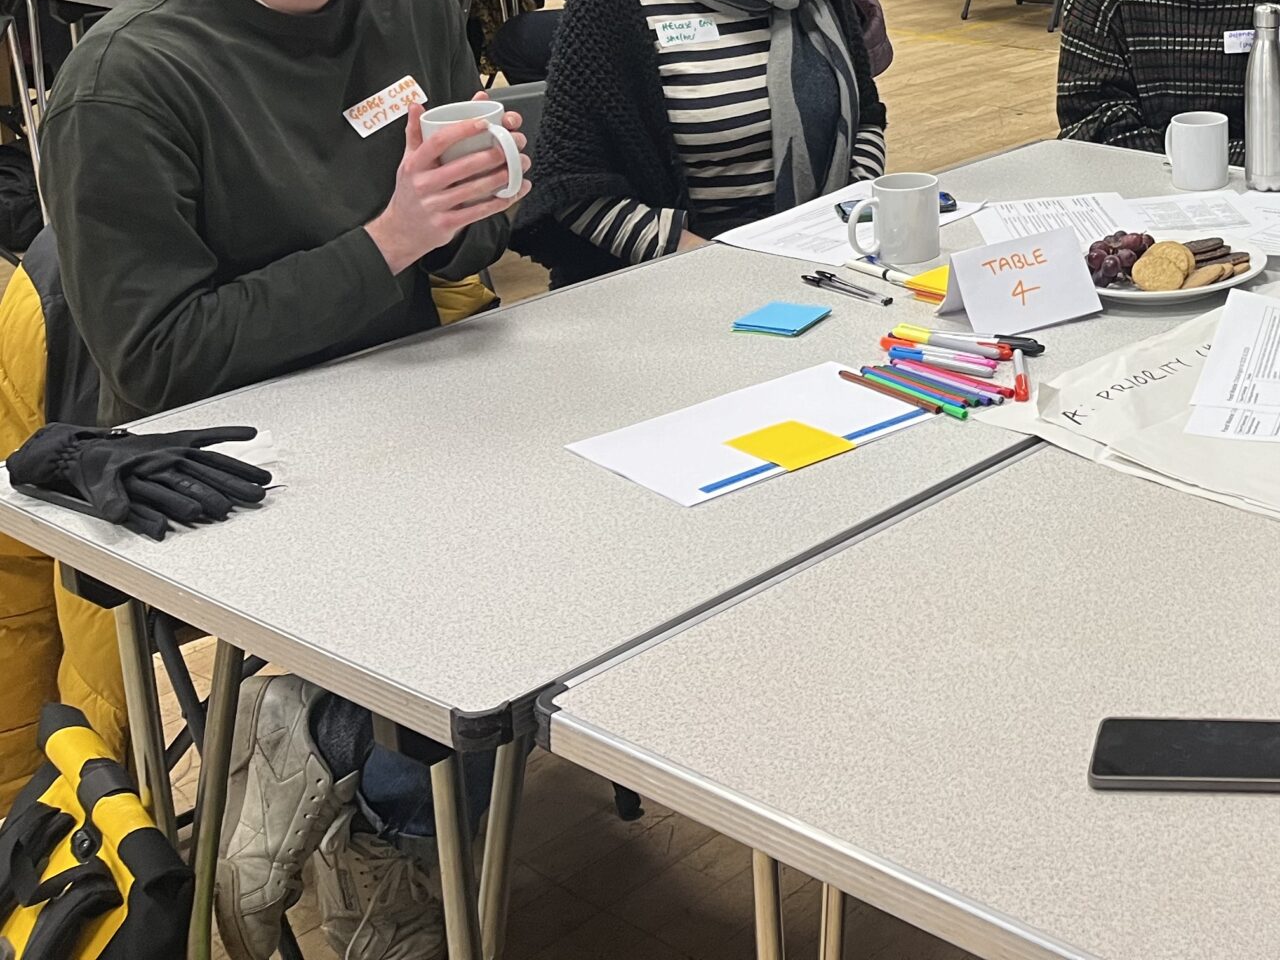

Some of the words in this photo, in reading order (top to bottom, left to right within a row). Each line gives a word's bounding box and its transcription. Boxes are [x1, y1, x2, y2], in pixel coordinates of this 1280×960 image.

[348, 95, 385, 120] GEORGE
[363, 109, 388, 130] CITY
[389, 103, 400, 113] TO
[401, 90, 421, 106] SEA
[982, 248, 1048, 276] TABLE
[1011, 280, 1041, 306] 4
[1096, 357, 1193, 401] PRIORITY
